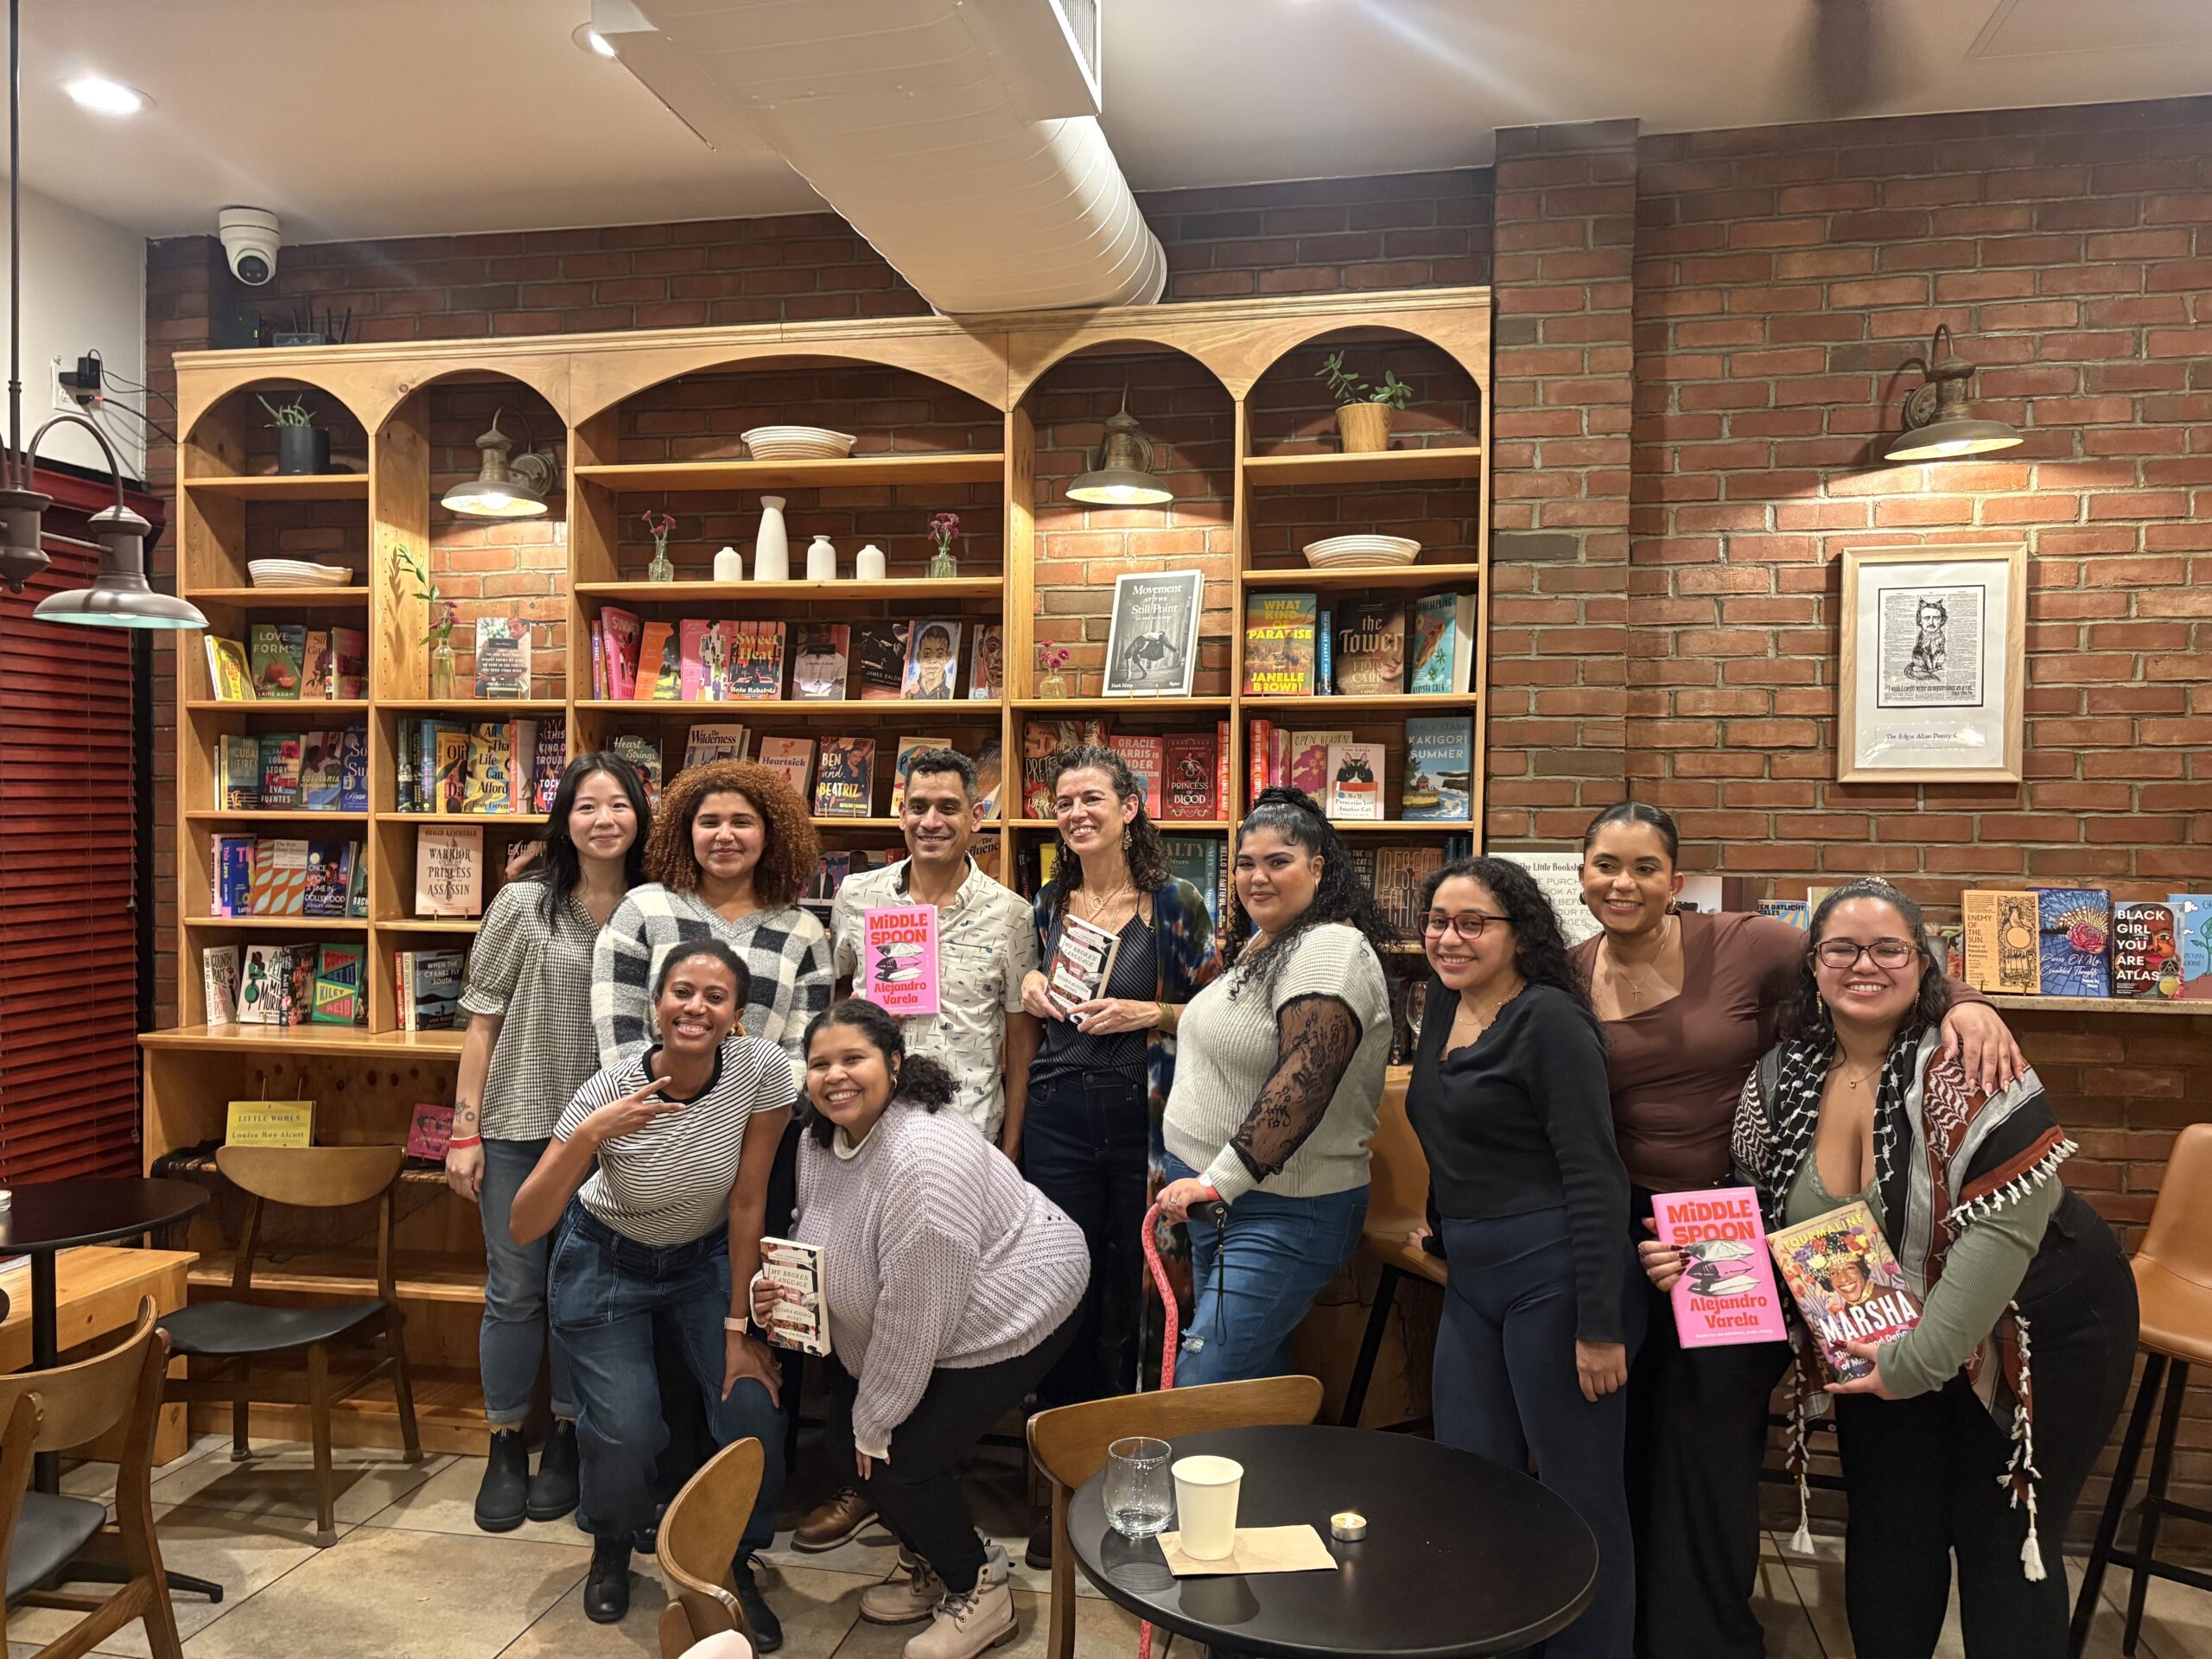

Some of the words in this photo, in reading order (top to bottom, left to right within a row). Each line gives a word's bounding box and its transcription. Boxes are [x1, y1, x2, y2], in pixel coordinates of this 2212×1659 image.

[1133, 584, 1182, 595] Movement
[1131, 605, 1152, 615] Still
[1153, 604, 1178, 613] Point
[1264, 601, 1300, 609] WHAT
[1265, 610, 1297, 620] KIND
[1273, 620, 1289, 629] OF
[1363, 615, 1382, 631] the
[259, 632, 290, 641] LOVE
[737, 632, 778, 645] Sweet
[1249, 629, 1313, 639] PARAISE
[1338, 629, 1404, 653] Tower
[253, 644, 296, 654] FORMS
[739, 647, 773, 660] Heat
[1251, 672, 1305, 682] JANELLE
[1253, 682, 1302, 692] BROWN
[485, 725, 497, 737] All
[546, 730, 565, 740] THIS
[691, 730, 736, 744] Wilderness
[613, 736, 642, 749] Heart
[1118, 739, 1155, 748] GRACIE
[1295, 734, 1316, 746] OPEN
[1408, 734, 1467, 745] KAKIGORI
[493, 740, 509, 752] Tha
[539, 743, 558, 752] KIND
[479, 753, 498, 766] Life
[626, 749, 656, 760] Strings
[822, 753, 842, 766] BEN
[1410, 749, 1464, 759] SUMMER
[762, 756, 806, 766] Heartsick
[266, 766, 289, 774] STORY
[486, 767, 503, 779] Can
[822, 765, 844, 778] and
[478, 781, 508, 794] Afford
[819, 782, 859, 798] BEATRIZ
[261, 795, 291, 804] FUENTES
[1174, 795, 1205, 805] BLOOD
[429, 848, 472, 862] WARRIOR
[427, 866, 472, 879] PRINCESS
[1533, 862, 1551, 871] Little
[428, 883, 470, 898] ASSASSIN
[1218, 869, 1227, 907] BEAUTIFUL
[305, 893, 345, 903] DOLLYWOOD
[2117, 910, 2165, 920] BLACK
[2116, 924, 2151, 934] GIRL
[870, 929, 927, 945] SPOON
[2116, 939, 2147, 950] YOU
[1065, 941, 1073, 950] MY
[1073, 946, 1097, 962] BROKEN
[2040, 952, 2065, 963] Pieces
[211, 952, 232, 968] COUNTRY
[325, 951, 347, 969] COME
[1065, 949, 1094, 968] LANGUAGE
[2116, 956, 2145, 966] ARE
[213, 967, 226, 984] PLACE
[327, 969, 343, 982] GET
[346, 966, 354, 983] IT
[2116, 969, 2159, 981] ATLAS
[320, 985, 345, 1001] KILEY
[874, 981, 927, 995] Alejandro
[883, 994, 918, 1005] Varela
[327, 1001, 350, 1015] REID
[1673, 1221, 1756, 1245] SPOON
[1783, 1213, 1864, 1249] TOURMALINE
[783, 1270, 809, 1281] BROKEN
[1690, 1294, 1768, 1314] Alejandro
[1704, 1312, 1759, 1329] Varela
[1818, 1290, 1918, 1348] MARSHA
